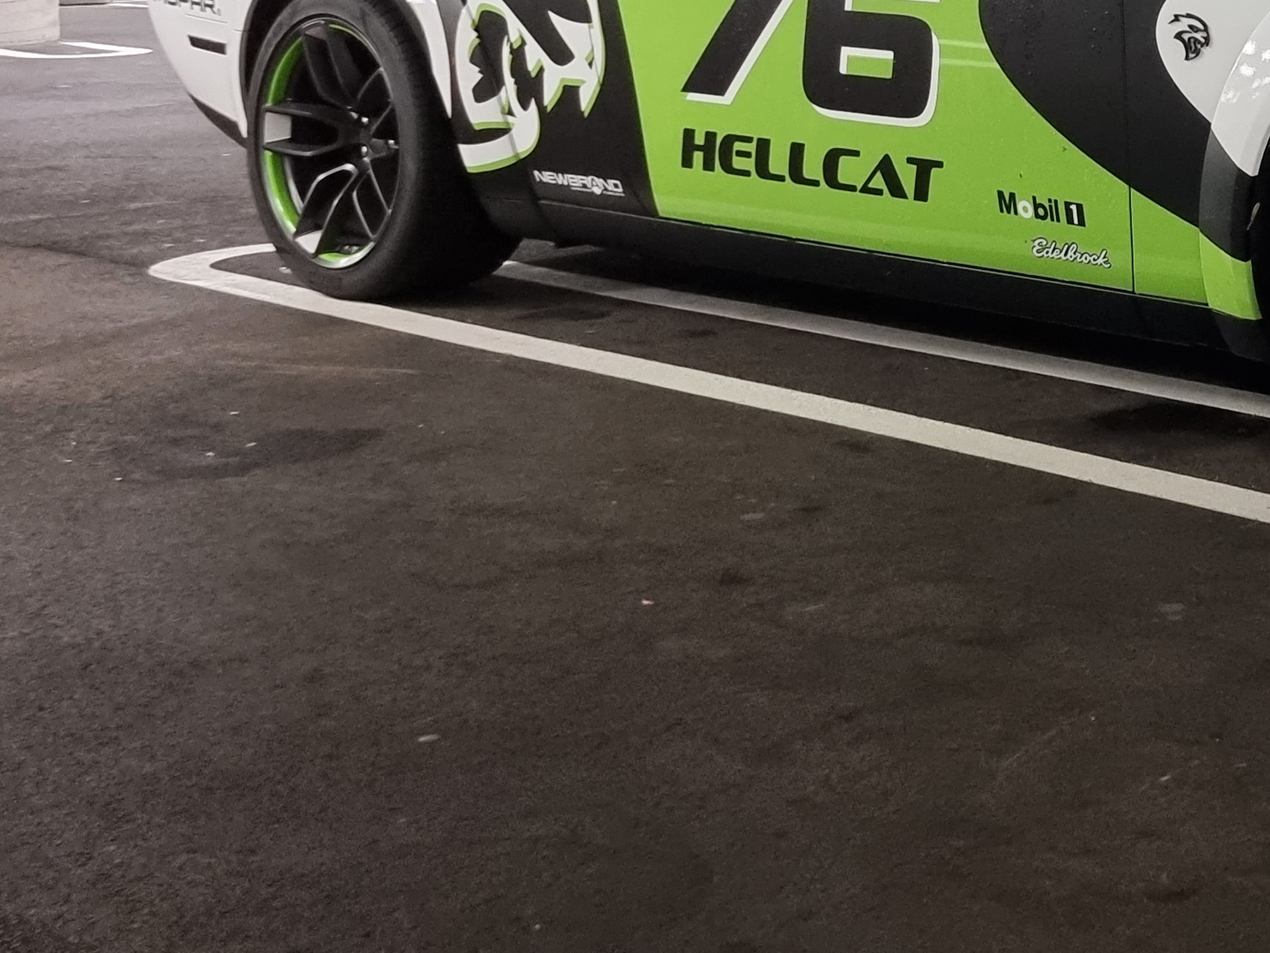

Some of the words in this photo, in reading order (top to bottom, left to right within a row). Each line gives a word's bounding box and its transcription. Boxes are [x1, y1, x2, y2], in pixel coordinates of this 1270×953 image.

[681, 127, 944, 202] HELLCAT
[996, 189, 1061, 223] Mobil
[1066, 202, 1082, 226] 1
[1031, 236, 1112, 269] Edelbrock
